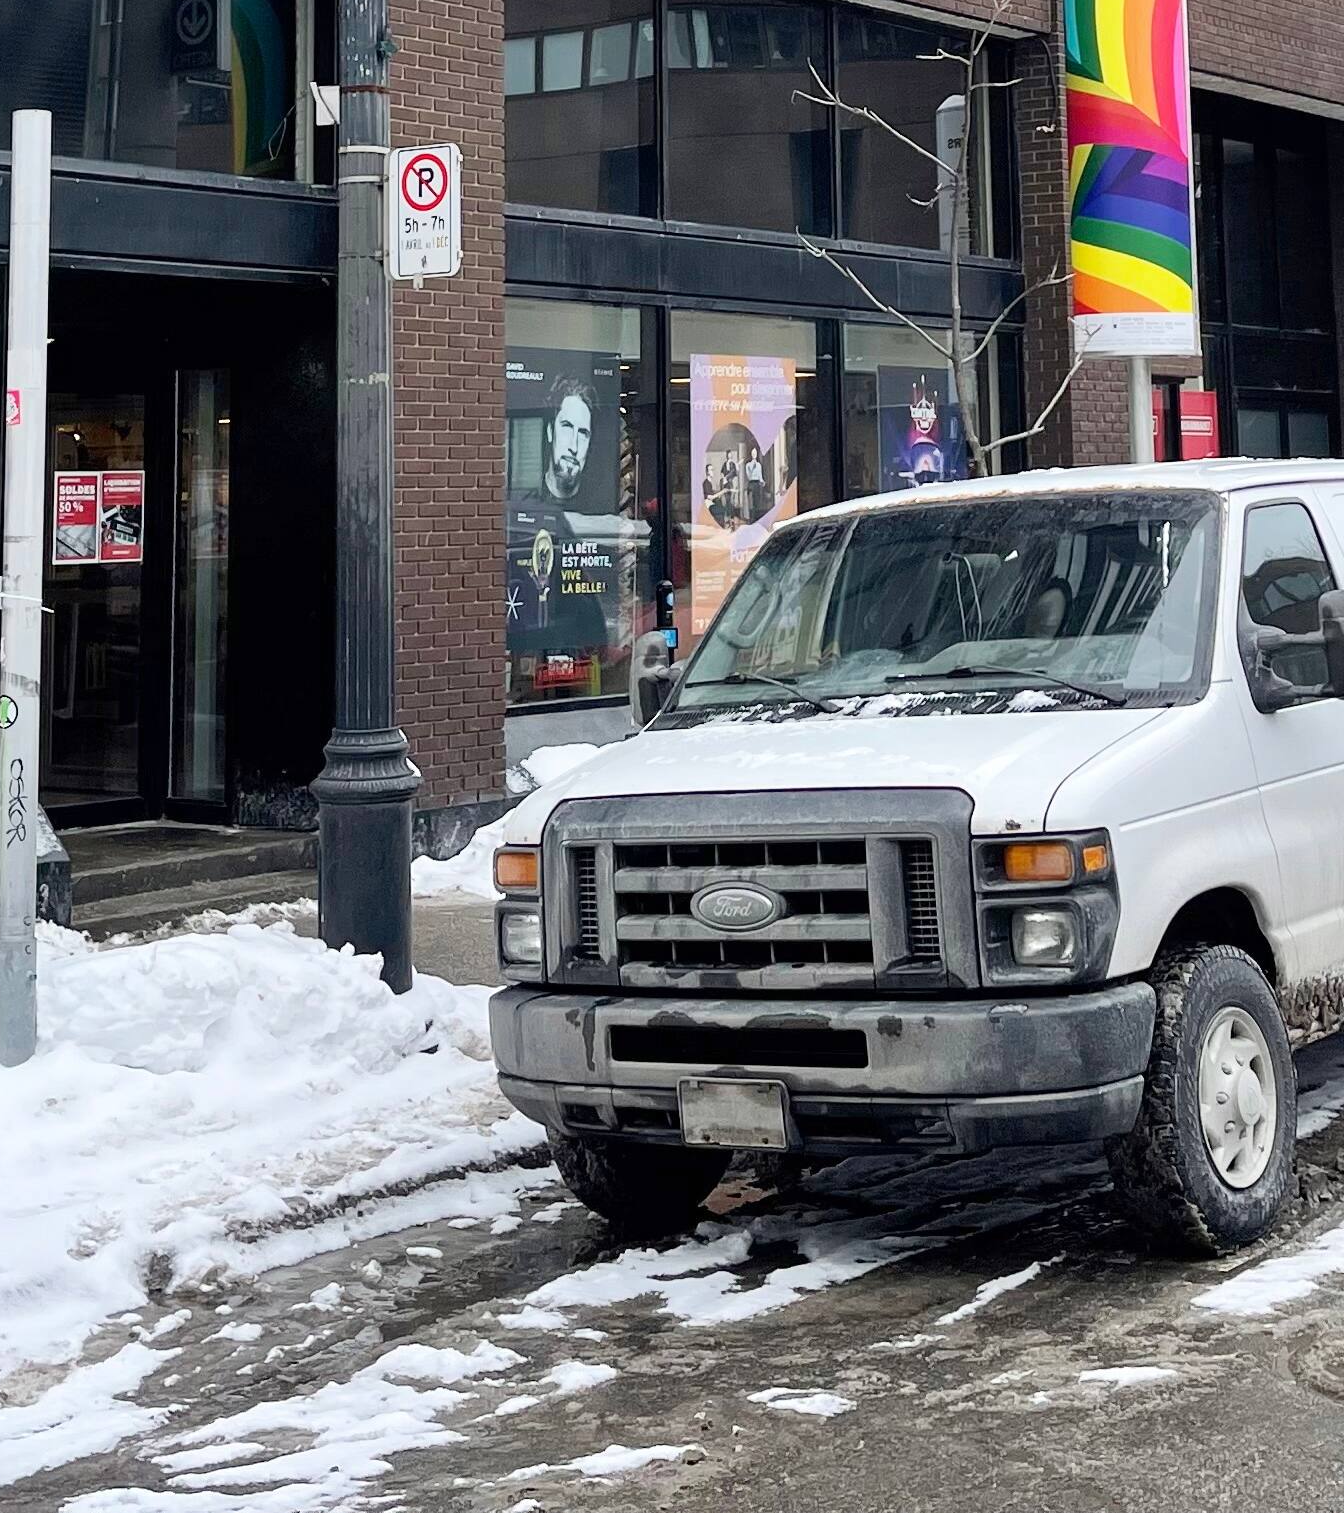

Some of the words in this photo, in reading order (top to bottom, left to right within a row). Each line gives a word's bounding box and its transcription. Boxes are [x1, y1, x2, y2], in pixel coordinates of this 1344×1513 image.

[405, 218, 419, 233] 5h
[431, 216, 445, 230] 7h
[59, 501, 72, 512] 50
[562, 544, 574, 554] LA
[561, 556, 577, 567] EST
[561, 570, 581, 580] VIVE
[562, 583, 573, 593] LA
[713, 895, 753, 917] Ford
